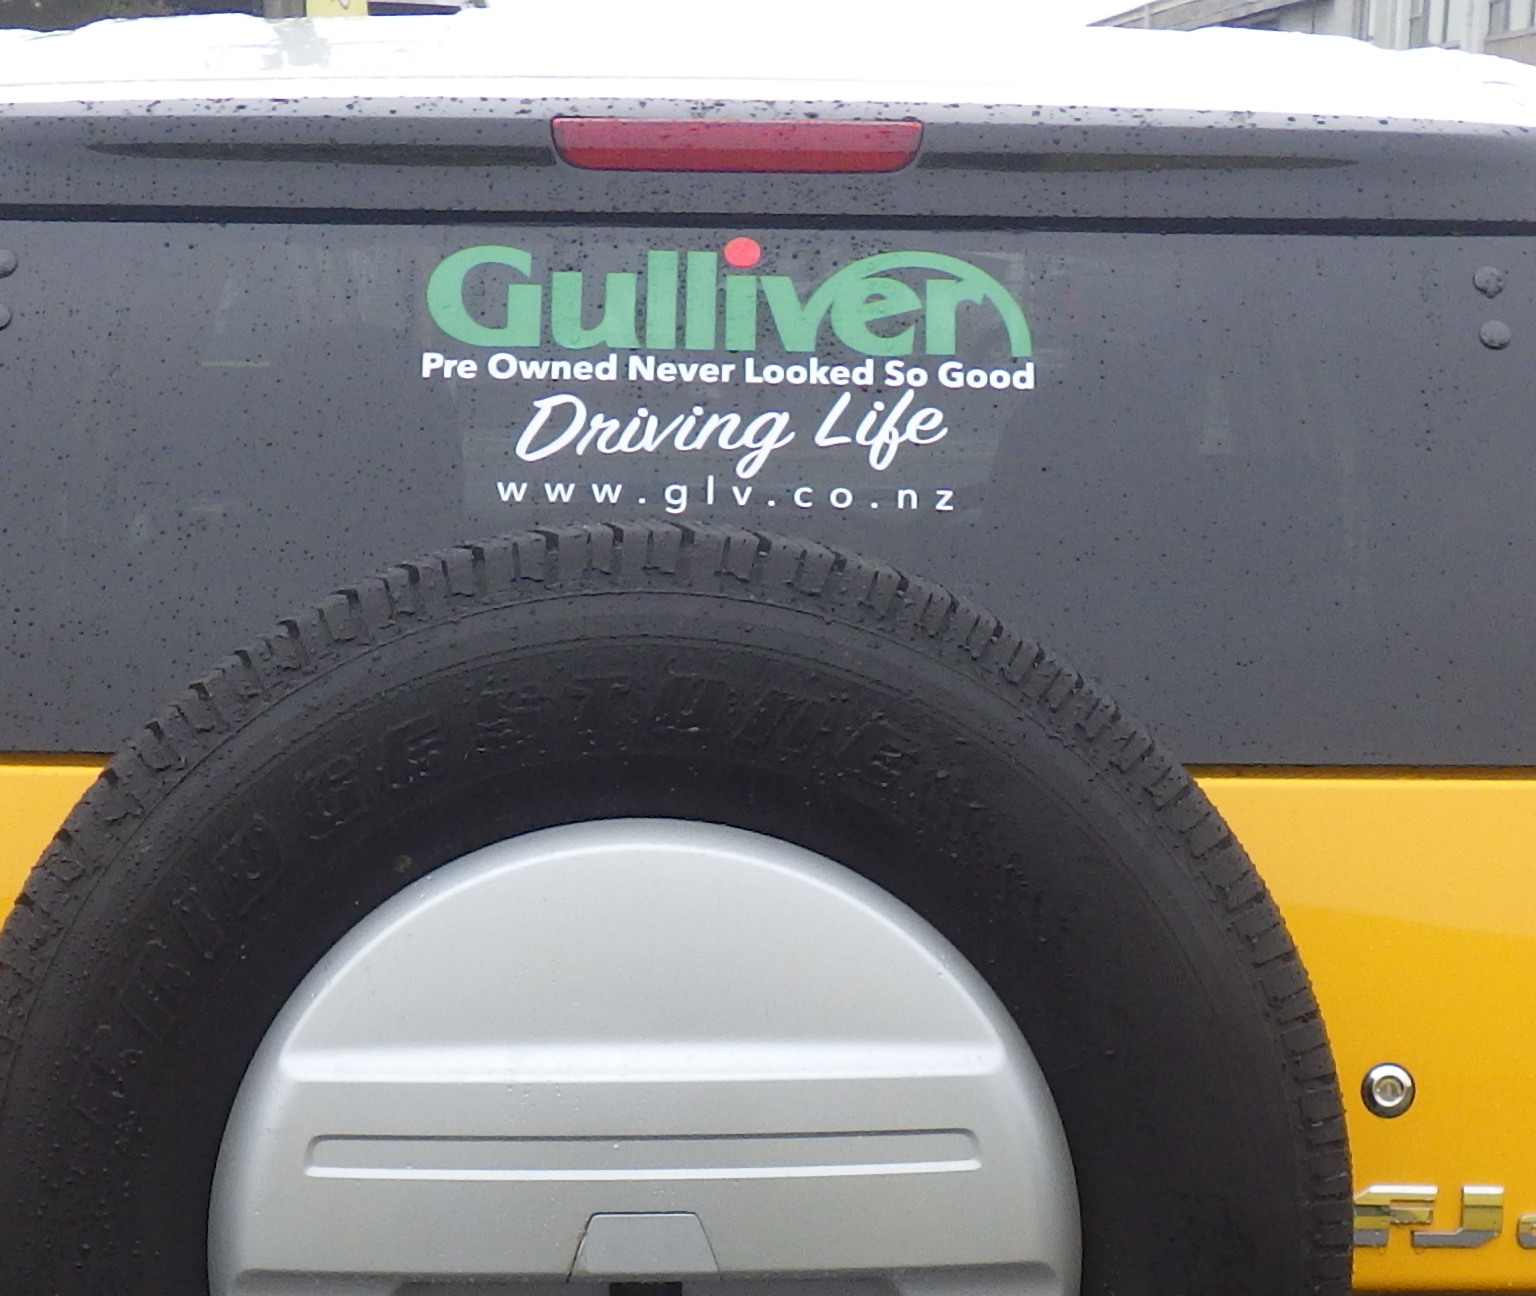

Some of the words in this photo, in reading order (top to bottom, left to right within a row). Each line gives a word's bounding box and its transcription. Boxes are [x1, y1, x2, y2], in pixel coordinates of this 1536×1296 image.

[426, 236, 1033, 358] Gulliver
[421, 351, 478, 378] Pre
[487, 352, 618, 381] Owned
[627, 355, 735, 382] Never
[744, 357, 875, 386] Looked
[884, 361, 929, 387] So
[937, 361, 1036, 390] Good
[514, 394, 796, 479] Driving
[813, 388, 949, 471] Life
[496, 474, 955, 514] www.glv.co.nz
[1352, 1183, 1505, 1249] FJ
